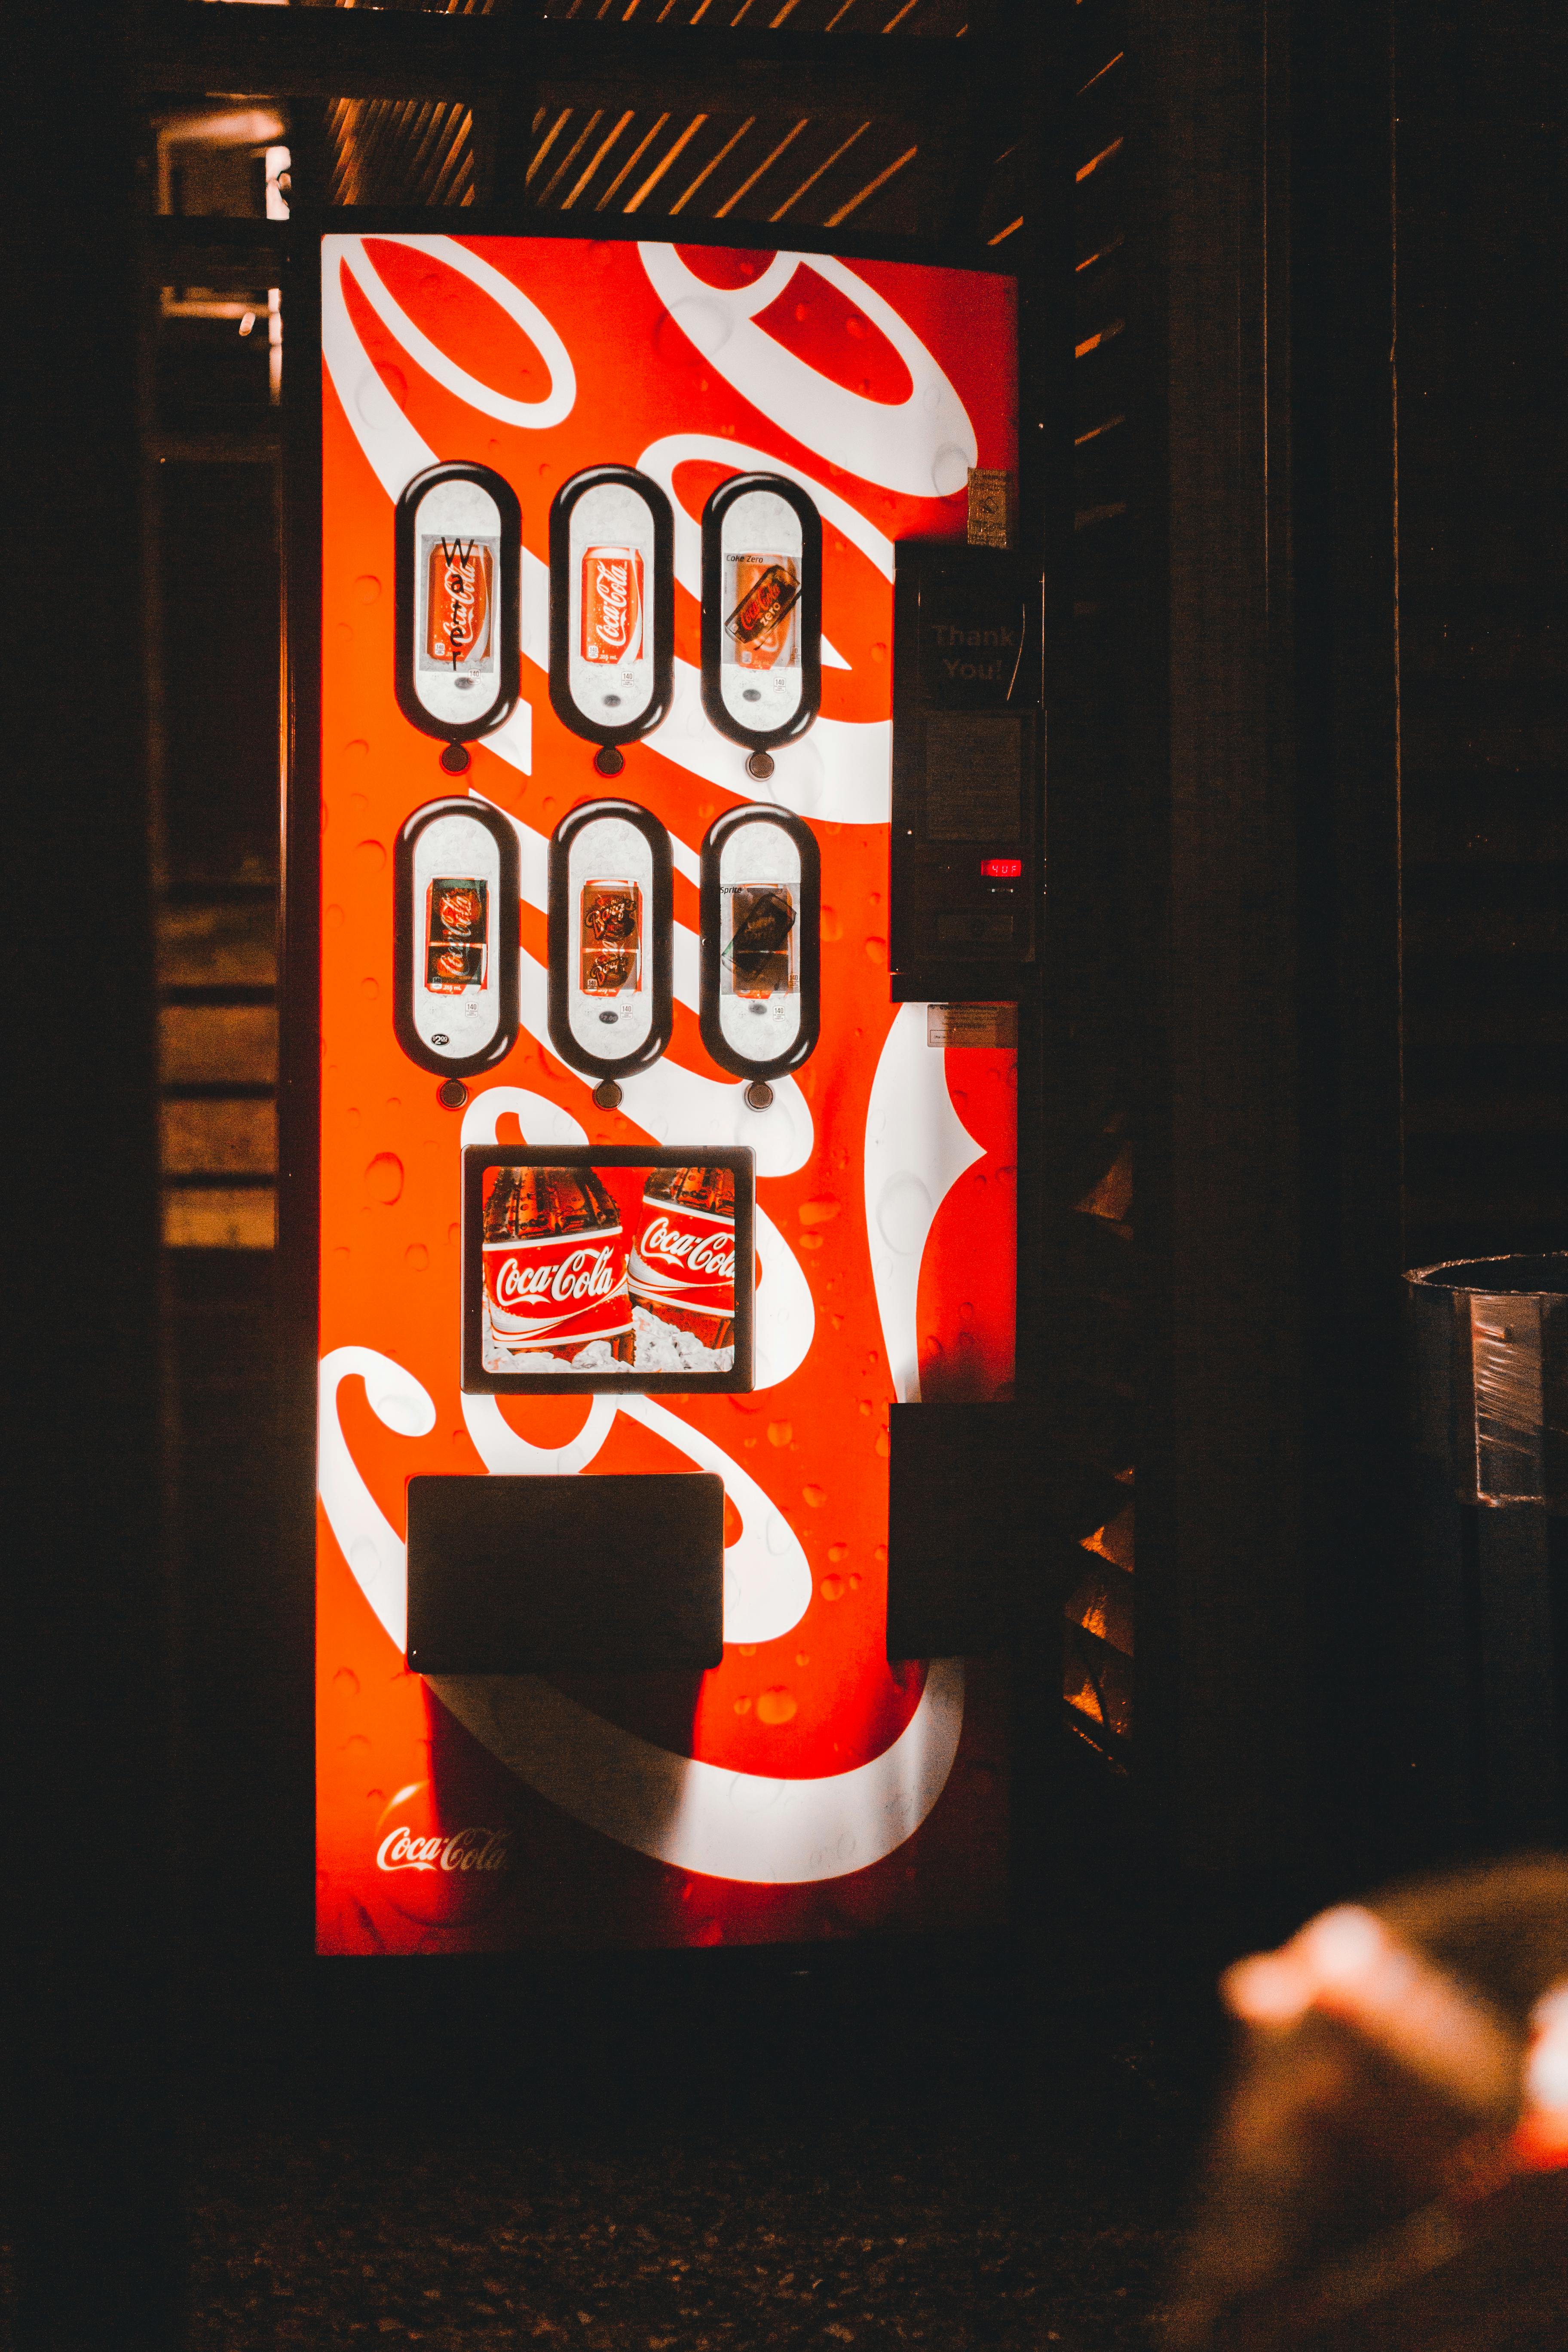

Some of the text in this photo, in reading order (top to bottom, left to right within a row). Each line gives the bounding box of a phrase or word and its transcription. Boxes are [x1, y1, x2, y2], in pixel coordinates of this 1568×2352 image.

[596, 560, 627, 646] Coca-Cola
[760, 602, 781, 626] zero
[931, 624, 1015, 646] Thank
[944, 659, 1003, 680] You!
[720, 886, 742, 894] Sprite
[496, 1244, 614, 1307] Coca-Cola
[377, 1826, 515, 1871] Coca-Cola
